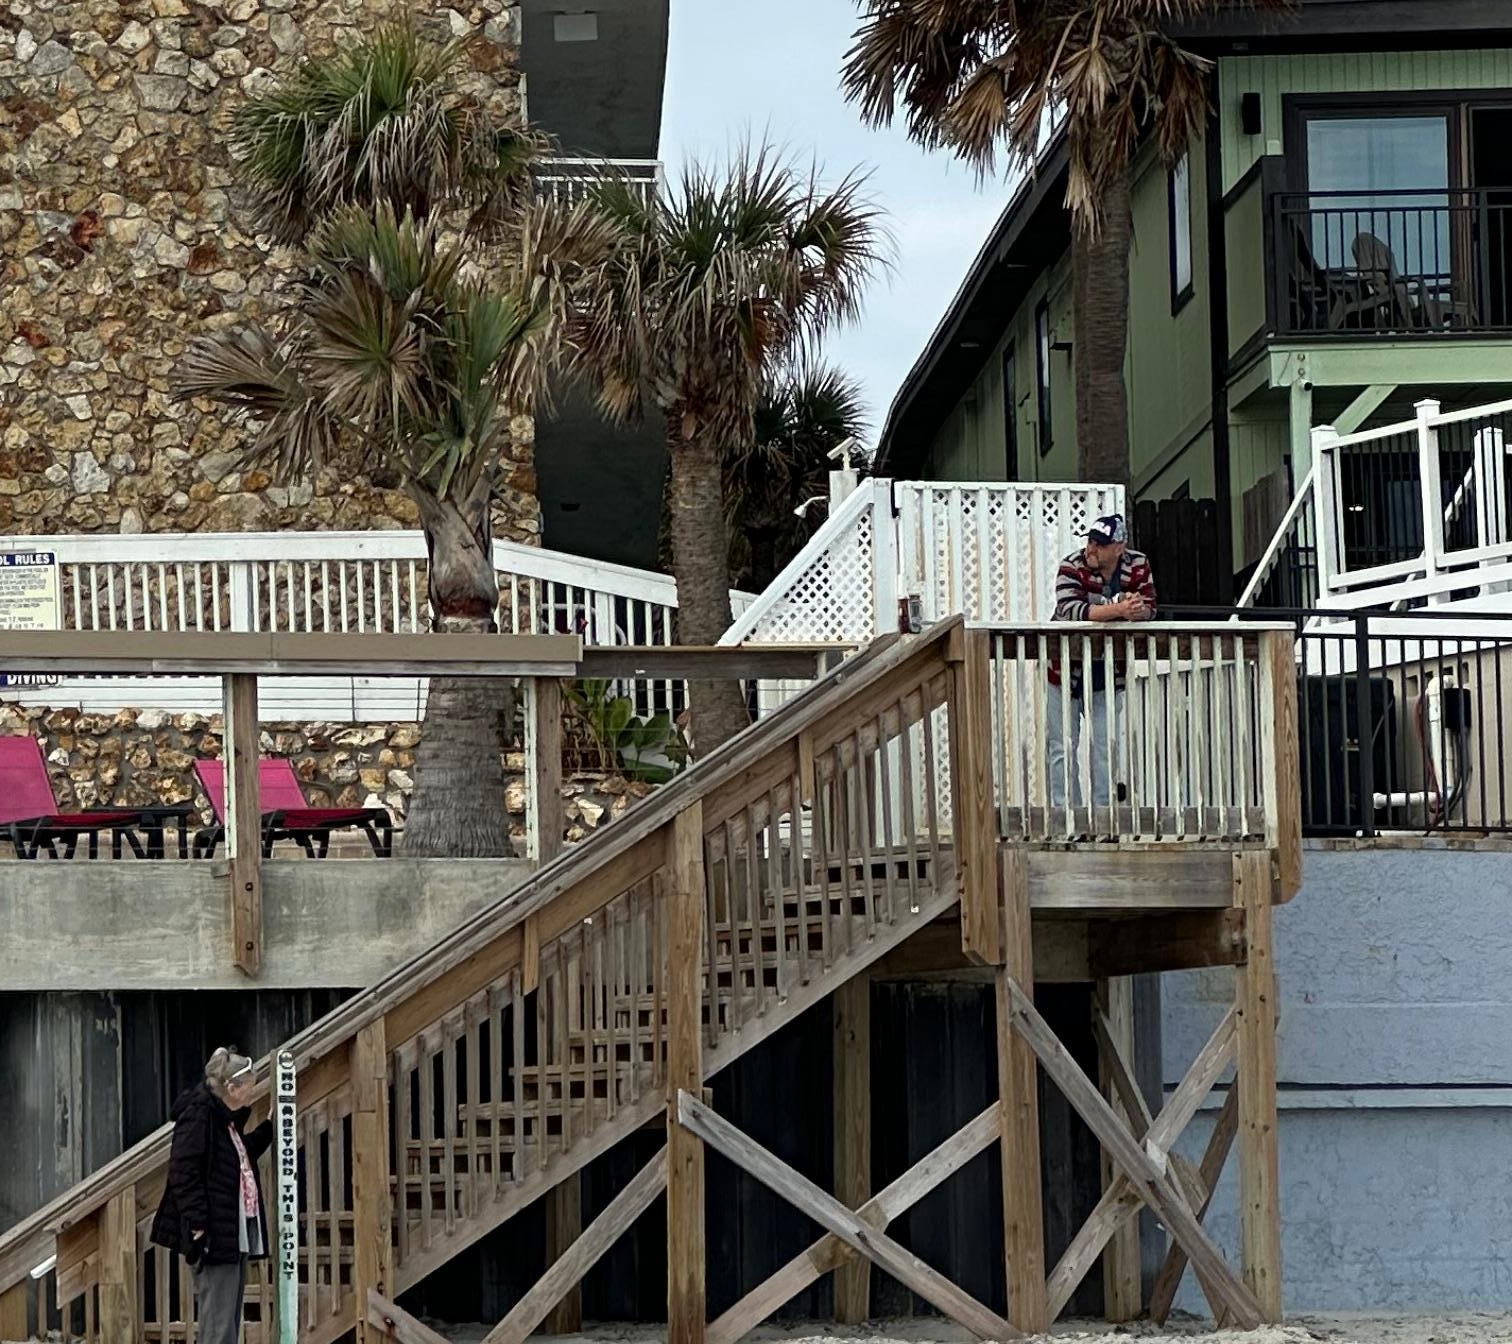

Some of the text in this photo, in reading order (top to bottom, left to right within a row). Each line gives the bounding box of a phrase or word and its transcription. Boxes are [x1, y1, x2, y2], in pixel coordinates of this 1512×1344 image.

[15, 554, 50, 564] RULES
[7, 675, 56, 685] DIVING
[281, 1072, 294, 1092] NO
[282, 1185, 294, 1223] THIS
[282, 1232, 295, 1280] POINT
